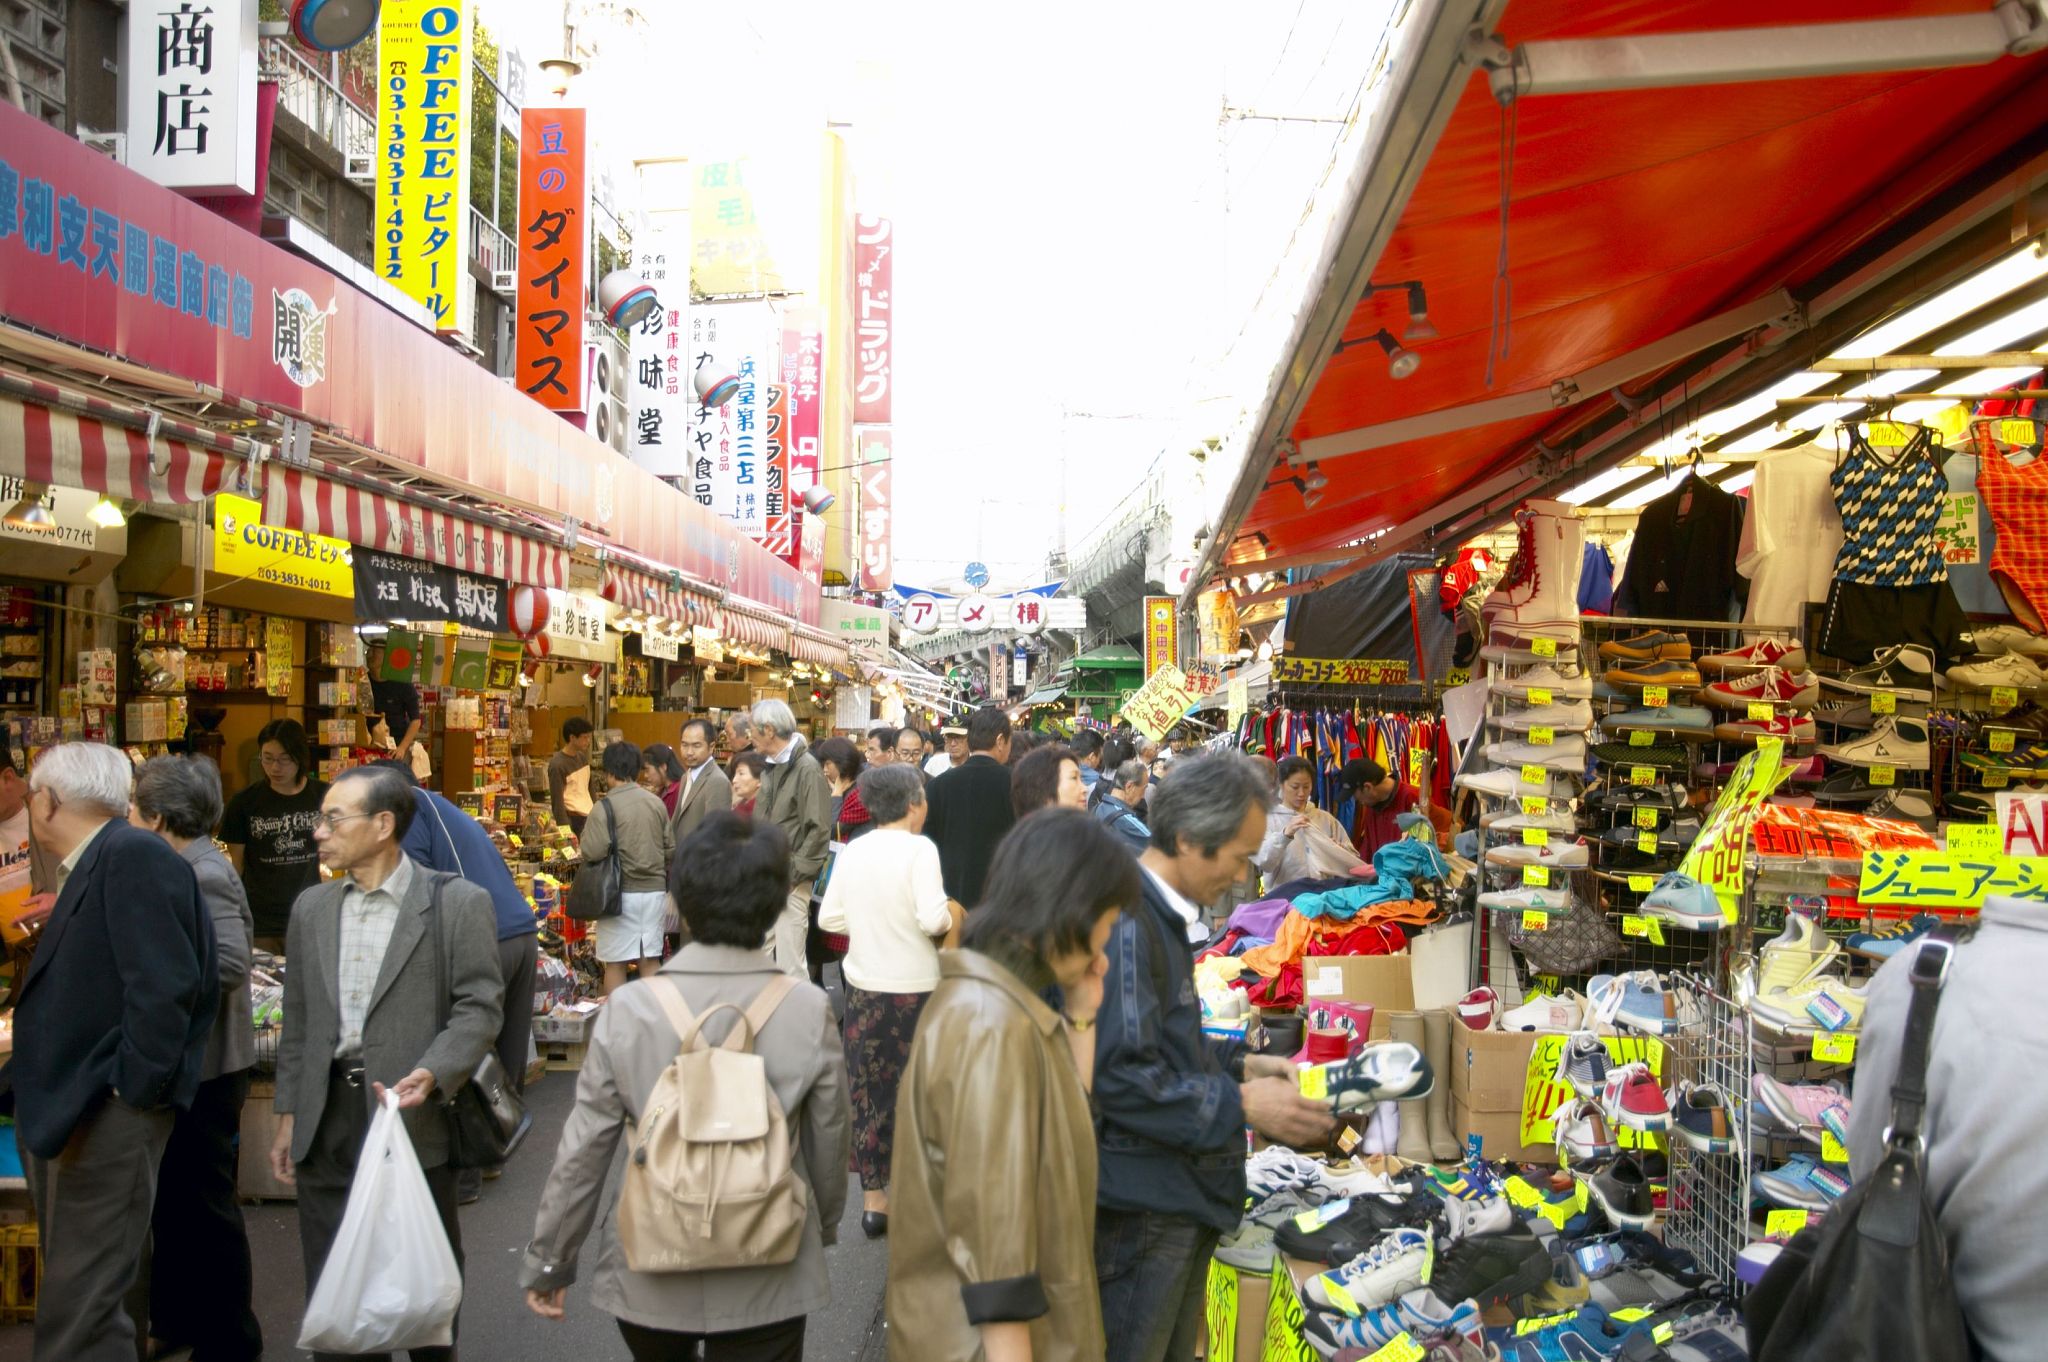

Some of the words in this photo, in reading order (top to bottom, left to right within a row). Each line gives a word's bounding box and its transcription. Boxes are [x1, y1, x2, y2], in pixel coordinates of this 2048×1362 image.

[153, 3, 213, 156] 商店
[388, 76, 407, 278] 03-3831-4012
[421, 193, 450, 319] ビタール
[667, 309, 680, 394] 健康食品
[857, 288, 889, 403] ドラッグ
[243, 523, 316, 560] COFFEE
[864, 471, 889, 577] くすり
[911, 602, 1041, 625] アメ横
